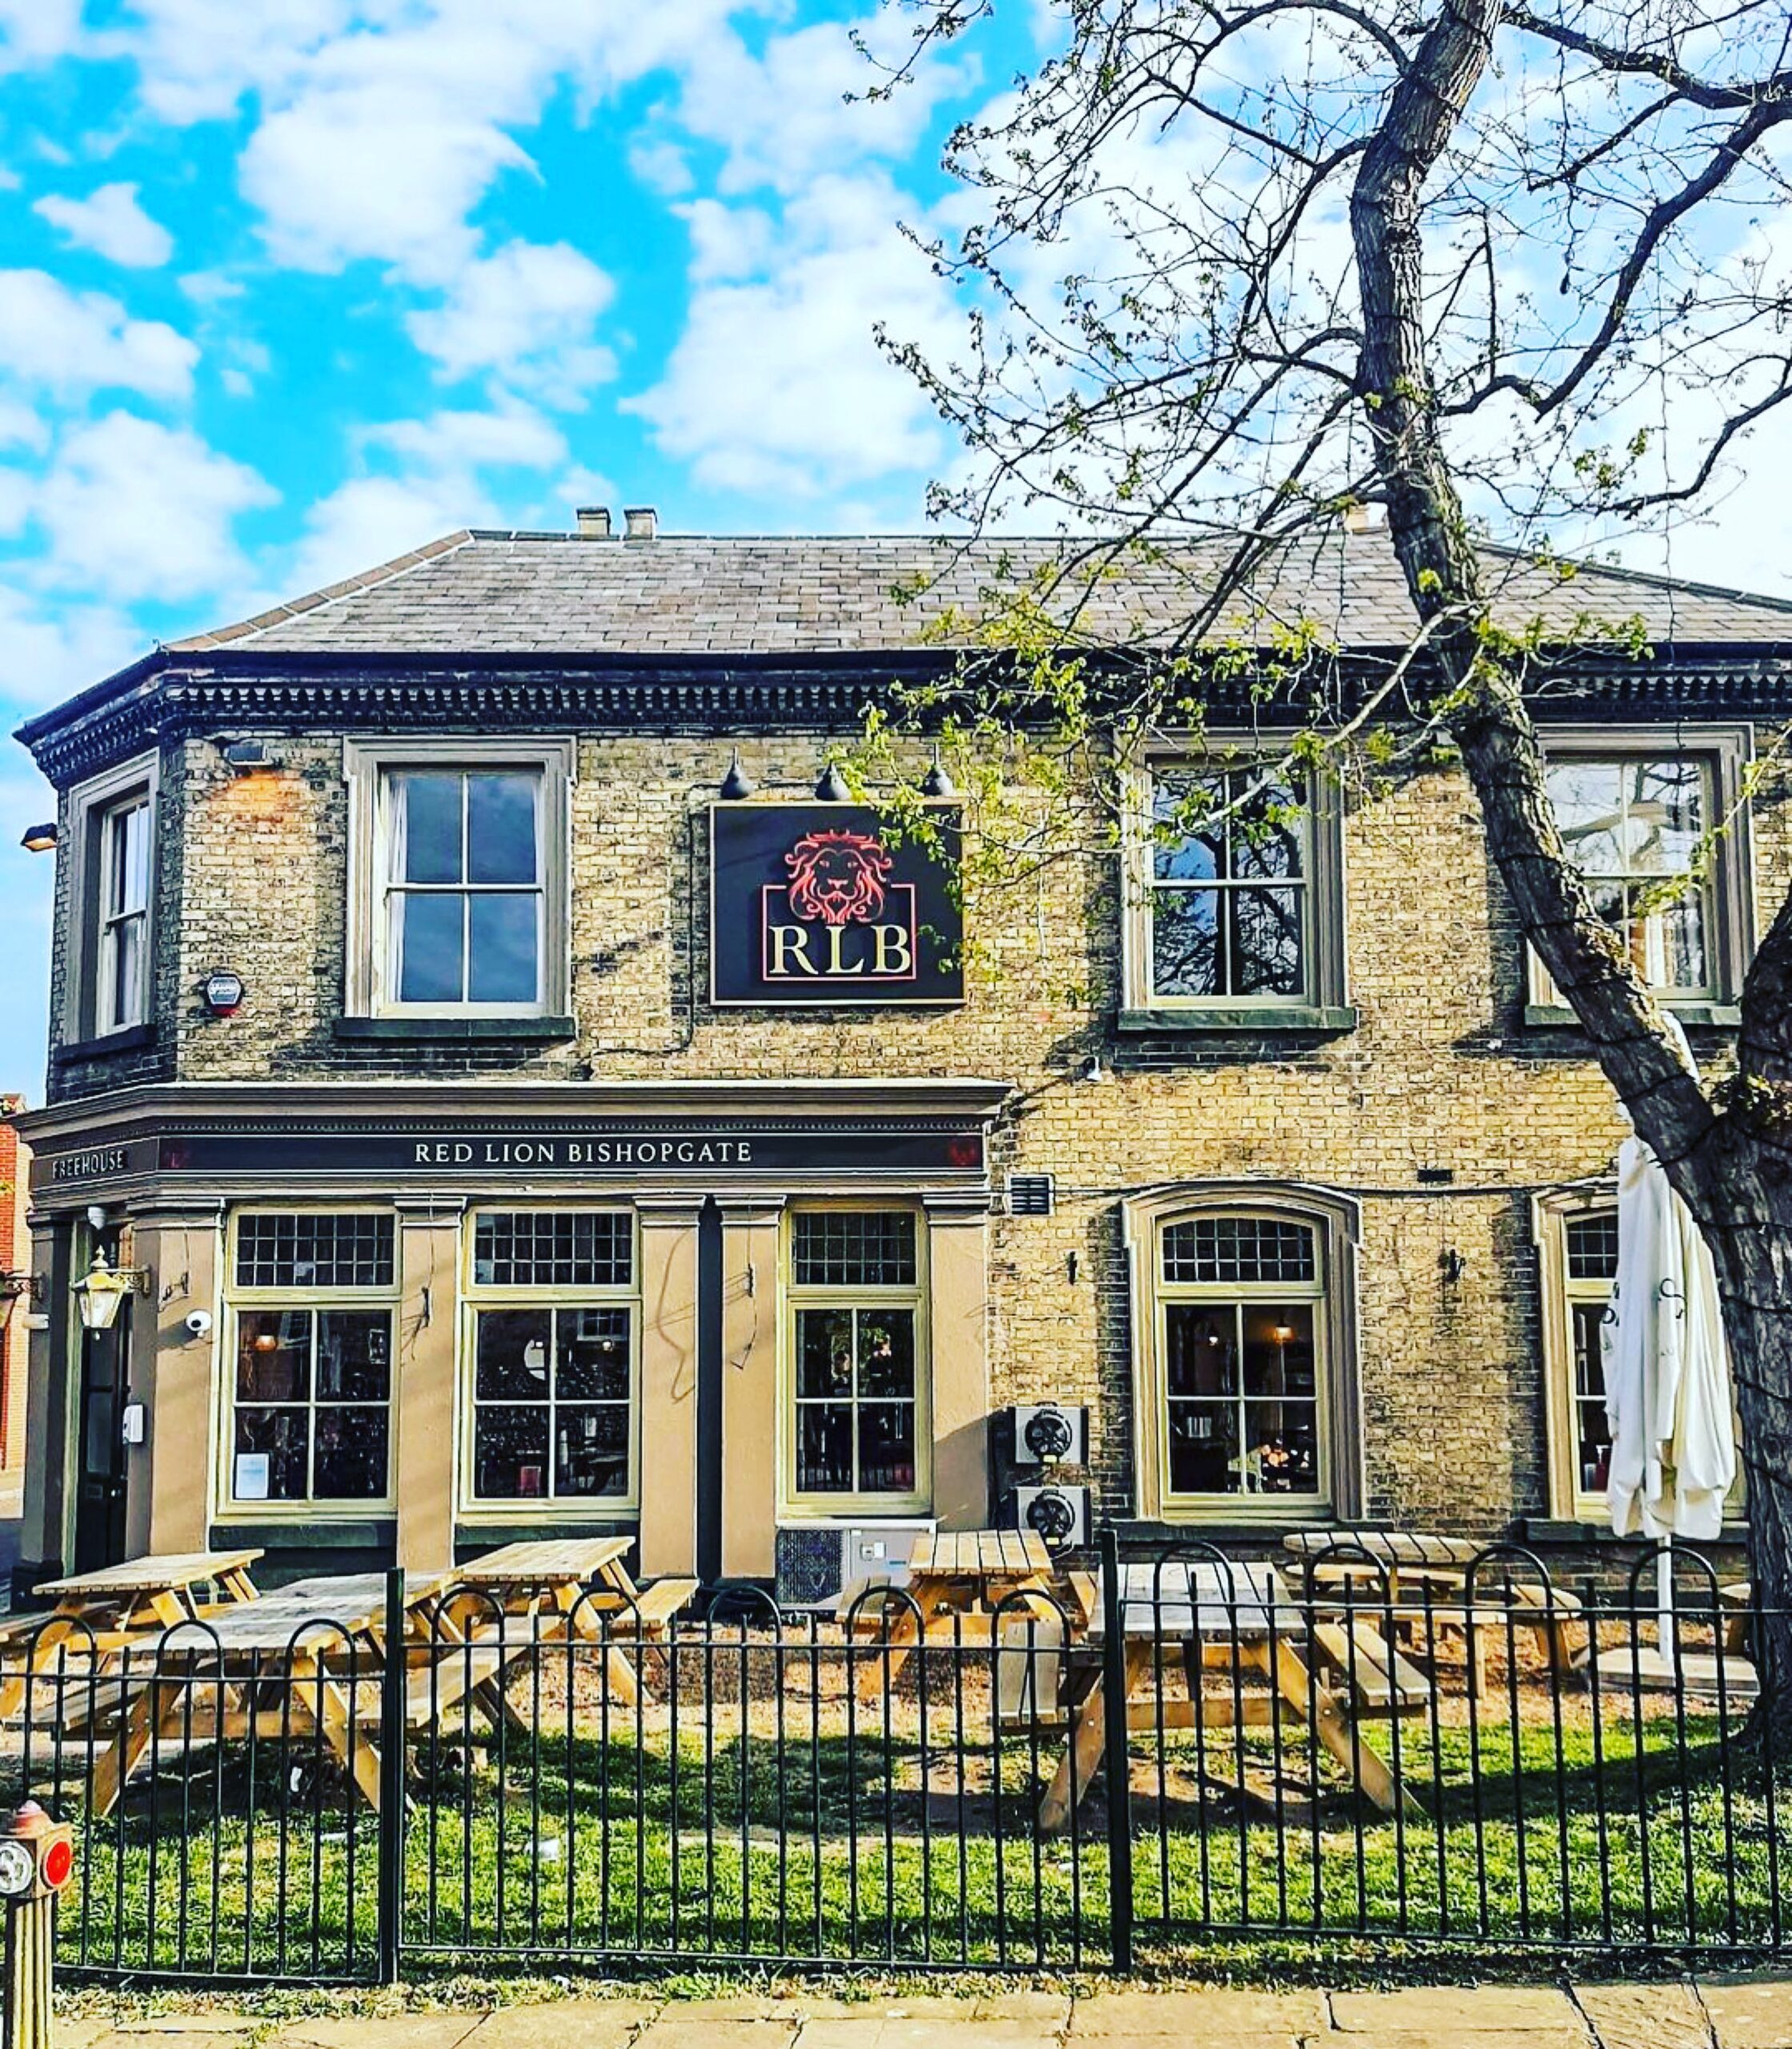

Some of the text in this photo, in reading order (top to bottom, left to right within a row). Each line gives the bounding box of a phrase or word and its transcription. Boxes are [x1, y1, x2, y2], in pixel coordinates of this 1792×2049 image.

[768, 924, 912, 975] RLB
[52, 1150, 123, 1179] FREEHOUSE
[414, 1142, 752, 1162] RED LION BISHOPGATE
